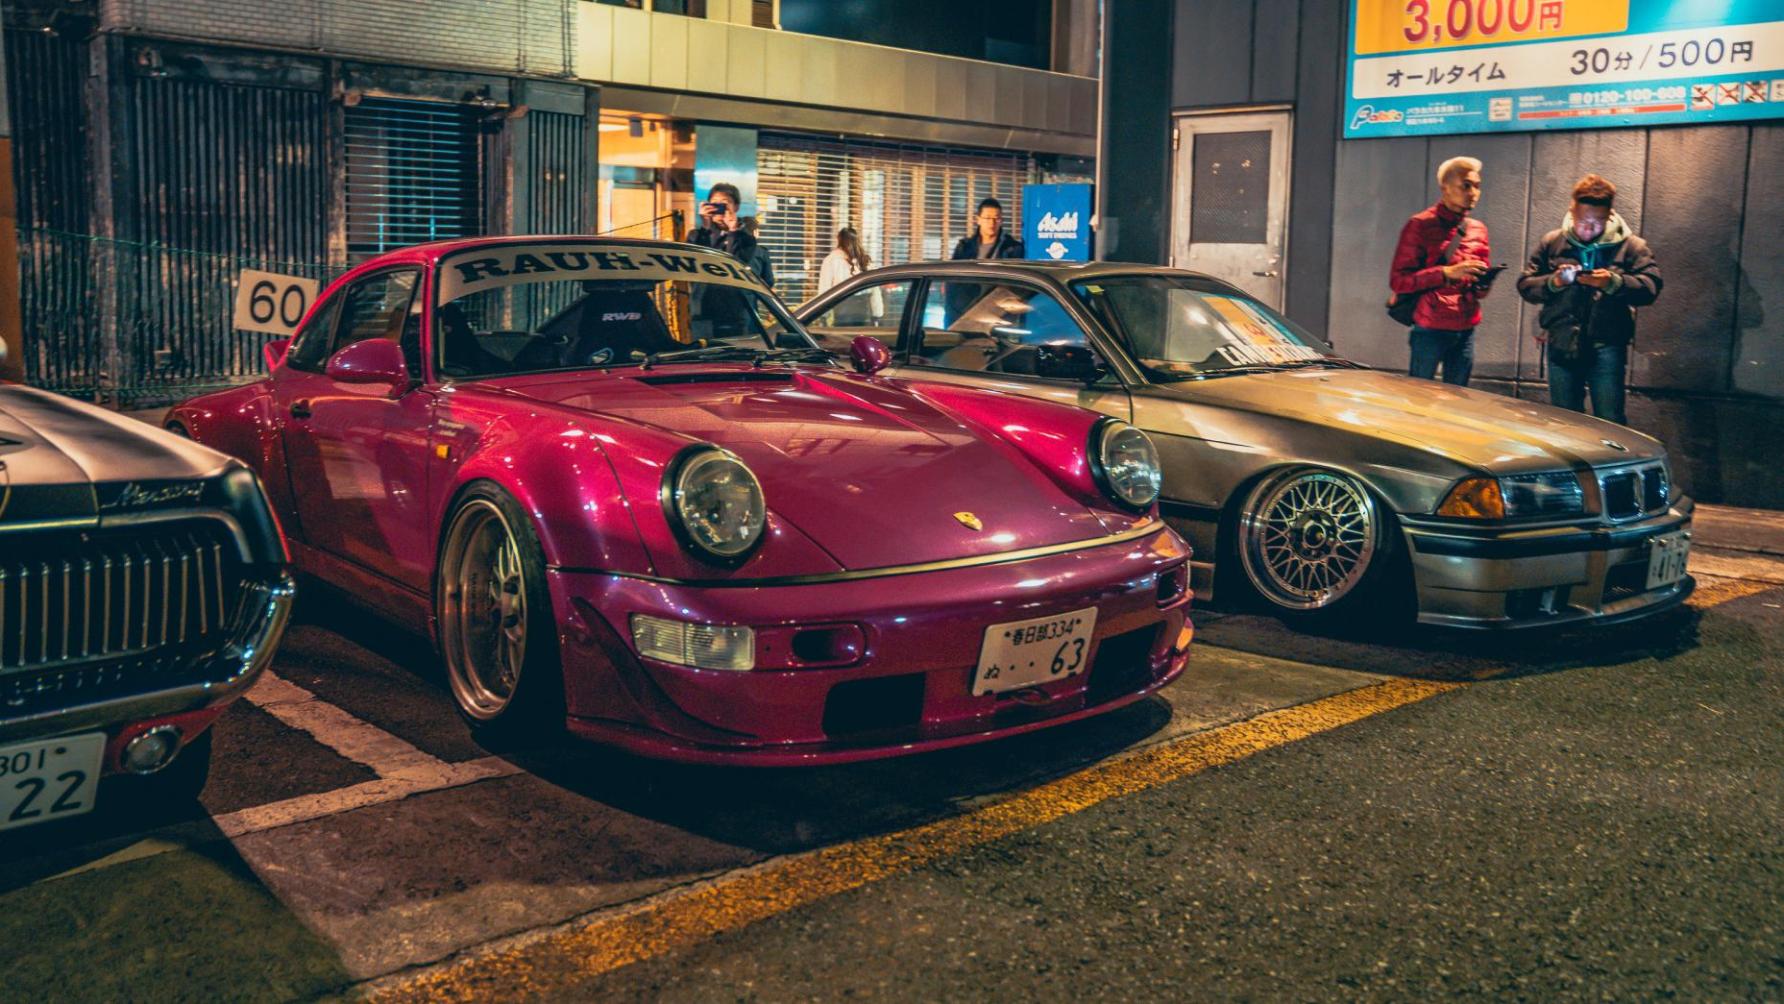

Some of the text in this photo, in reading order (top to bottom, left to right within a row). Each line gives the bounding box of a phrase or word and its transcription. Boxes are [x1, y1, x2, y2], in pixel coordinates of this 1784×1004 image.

[1404, 0, 1563, 42] 3,000円
[1387, 62, 1505, 88] オールタイム
[250, 280, 305, 328] 60
[1051, 638, 1086, 675] 63
[8, 769, 87, 822] 22
